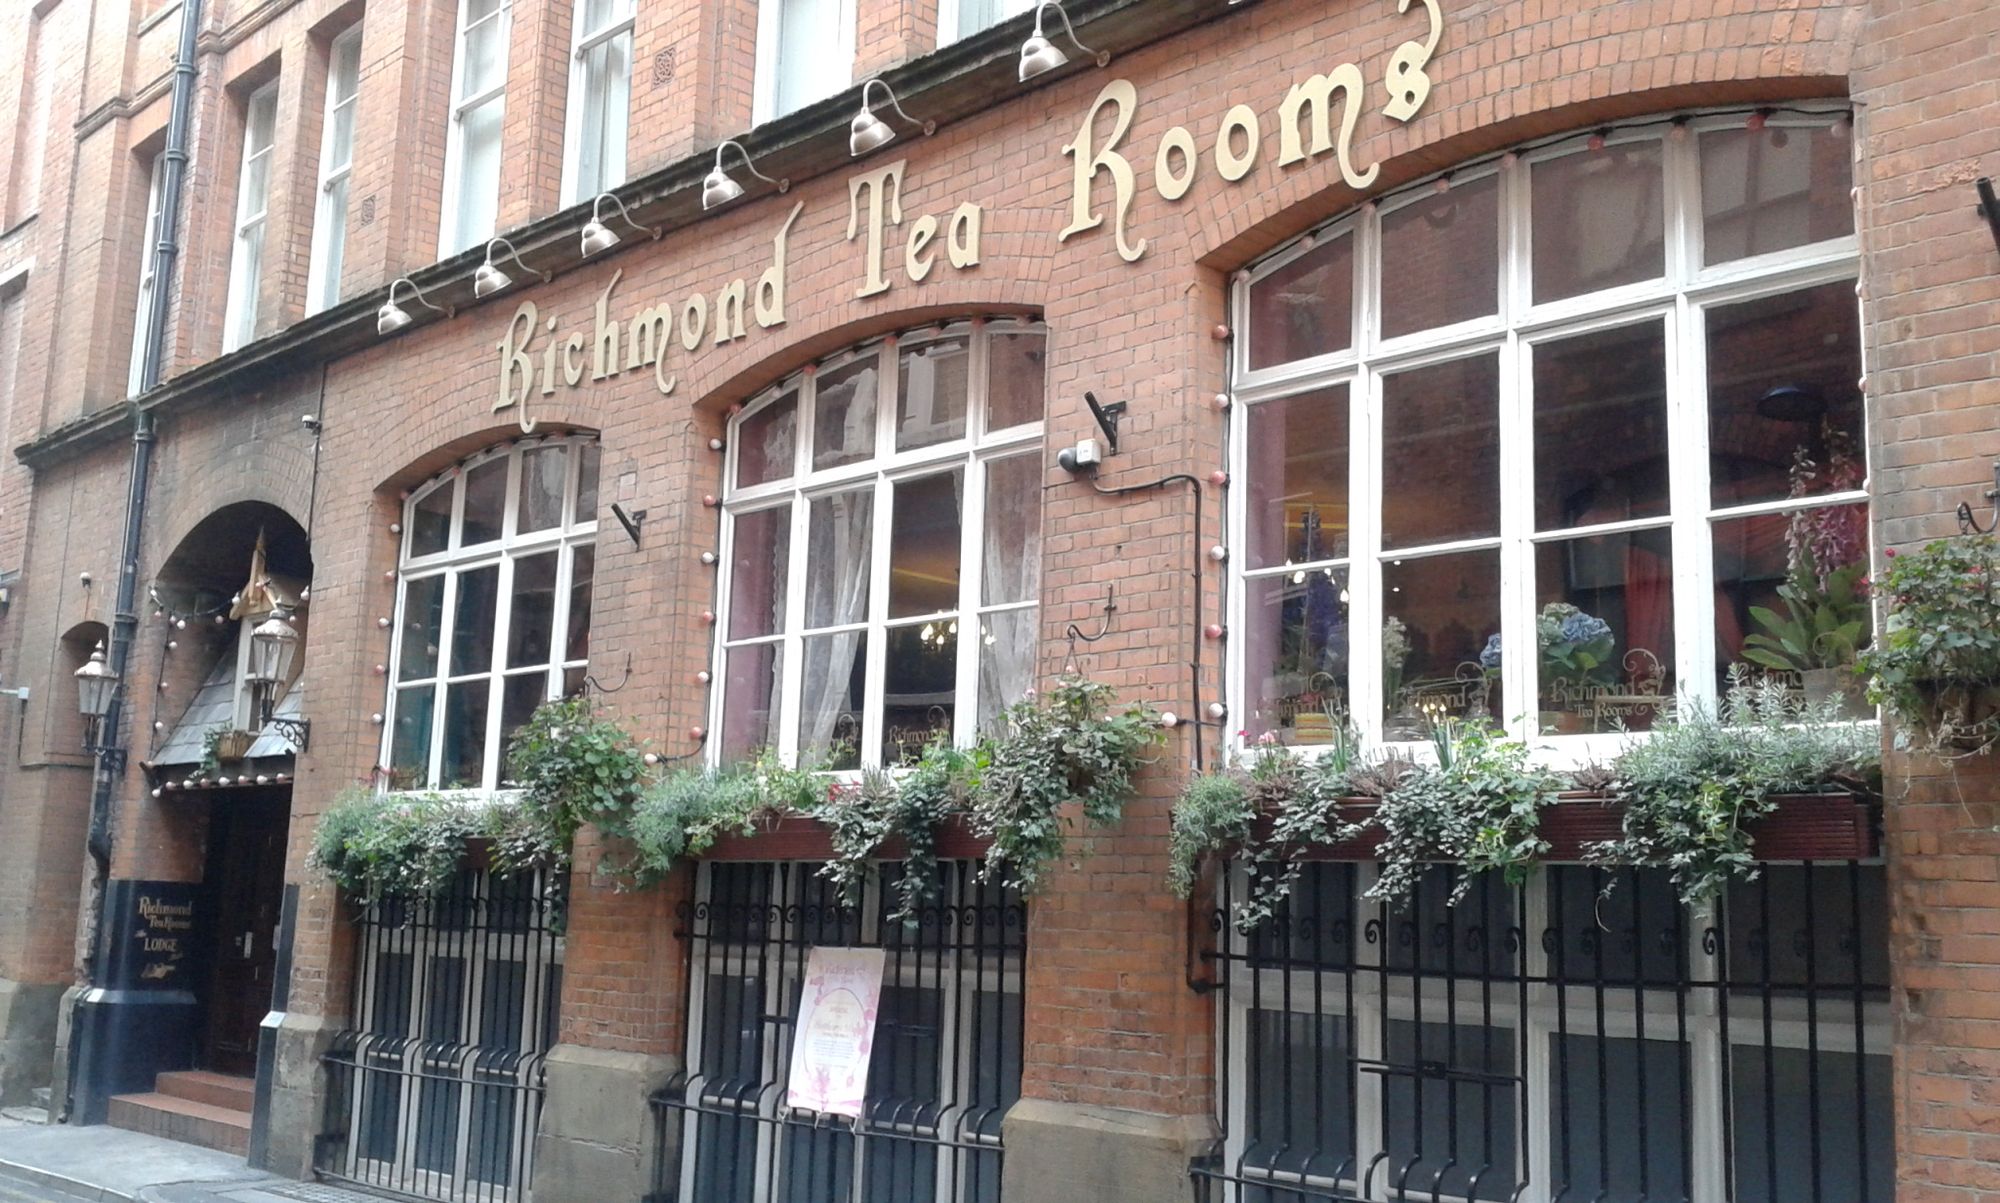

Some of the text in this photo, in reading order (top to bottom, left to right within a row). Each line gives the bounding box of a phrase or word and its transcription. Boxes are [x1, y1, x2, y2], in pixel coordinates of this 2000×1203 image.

[491, 0, 1442, 434] Richmond Tea Rooms
[1551, 672, 1640, 710] Richmond
[138, 896, 193, 919] Richmond
[144, 937, 178, 952] LODGE
